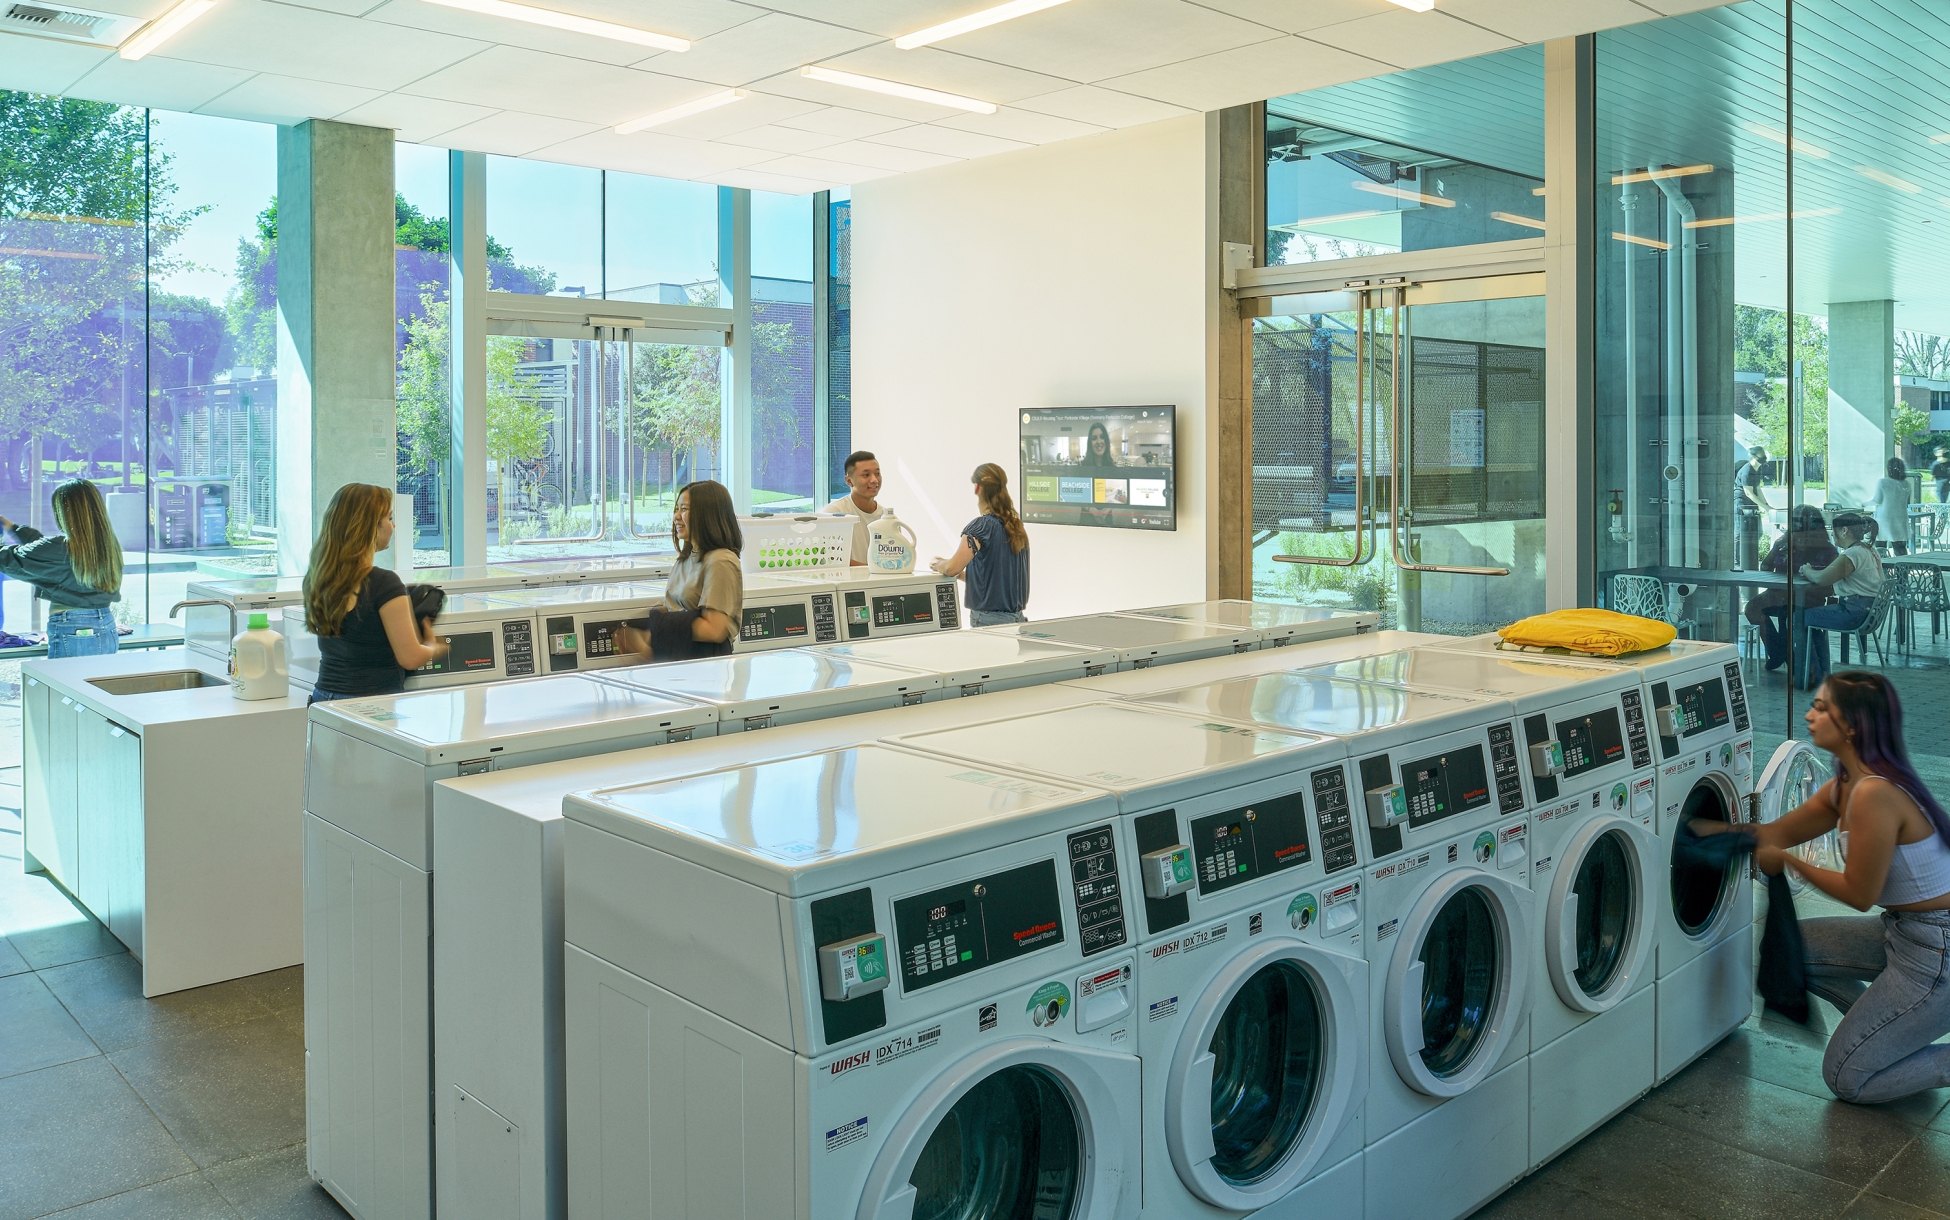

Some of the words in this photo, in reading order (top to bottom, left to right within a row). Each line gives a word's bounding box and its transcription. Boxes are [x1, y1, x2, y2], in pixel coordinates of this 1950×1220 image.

[878, 544, 904, 555] Downy
[1376, 864, 1395, 879] WASH
[1013, 926, 1036, 941] Speed
[1035, 921, 1057, 934] Queen
[1018, 933, 1043, 947] Commercial
[1042, 930, 1057, 941] Washer
[1152, 940, 1180, 958] WASH
[1183, 936, 1195, 948] IDX
[1196, 931, 1208, 943] 712
[831, 1050, 871, 1075] WASH
[876, 1043, 893, 1059] IDX
[896, 1037, 913, 1052] 714
[836, 1119, 858, 1135] NOTICE
